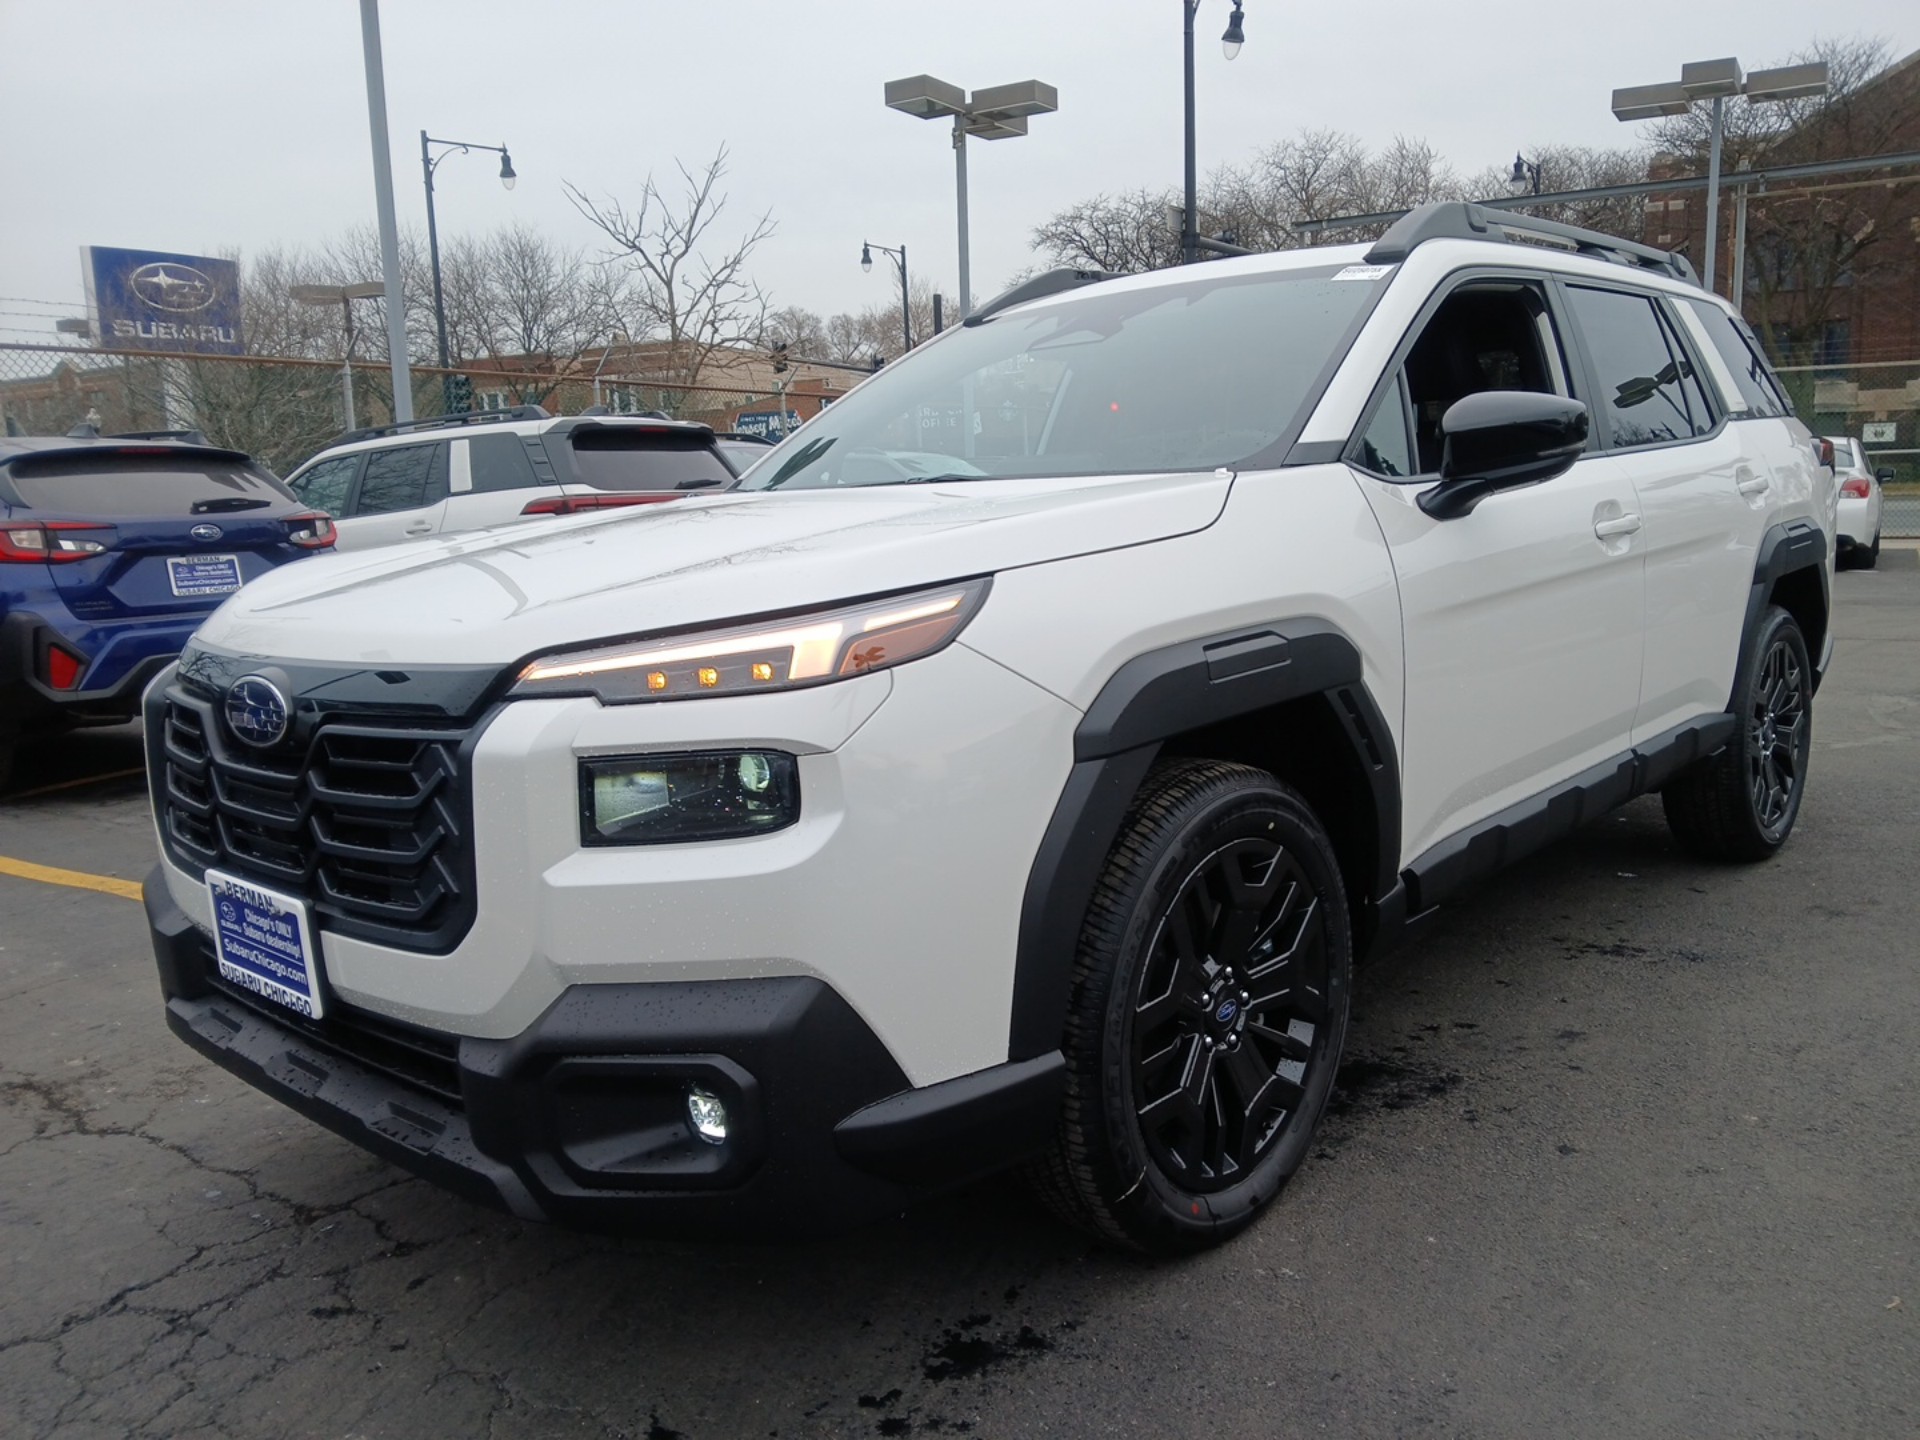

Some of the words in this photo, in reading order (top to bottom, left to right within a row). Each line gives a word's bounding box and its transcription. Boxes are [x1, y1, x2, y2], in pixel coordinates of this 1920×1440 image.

[113, 320, 235, 343] SUBARU
[224, 880, 272, 912] BERMAN
[223, 938, 307, 985] SubaruChicago.com
[221, 962, 262, 994] SUBARU
[264, 982, 312, 1016] CHICAGO
